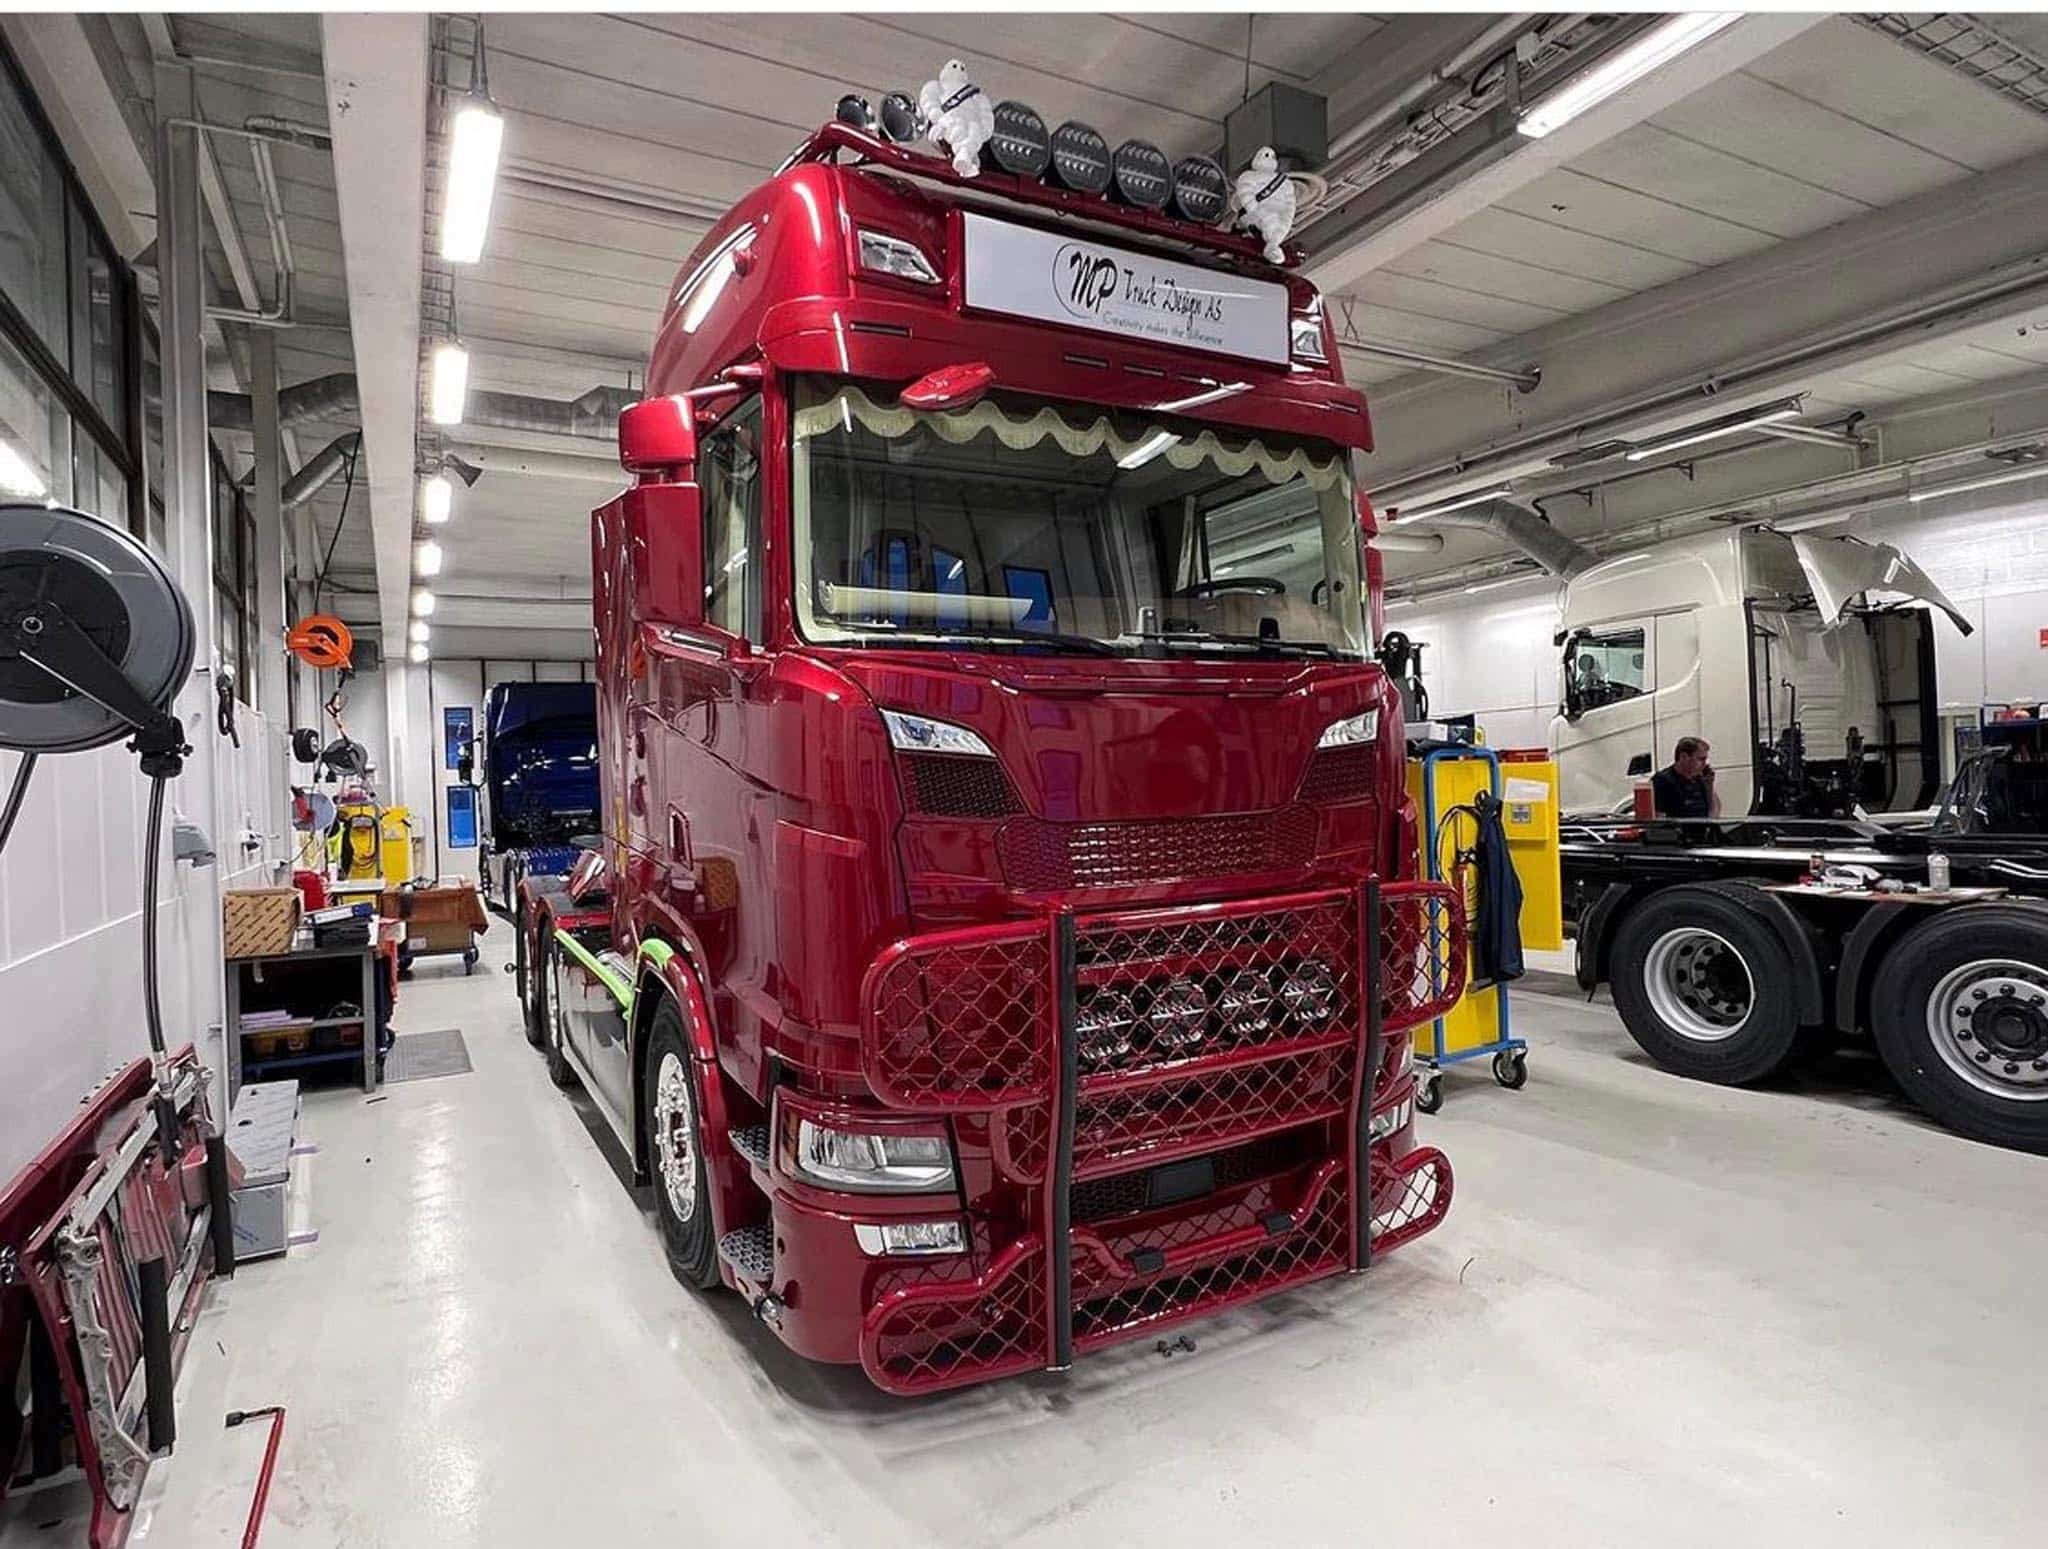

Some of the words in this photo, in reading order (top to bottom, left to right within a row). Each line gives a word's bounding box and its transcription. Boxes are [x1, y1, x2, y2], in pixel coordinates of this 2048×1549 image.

[1070, 251, 1118, 313] MP
[1123, 268, 1157, 306] Truck
[1162, 278, 1202, 331] Design
[1204, 296, 1222, 321] AS
